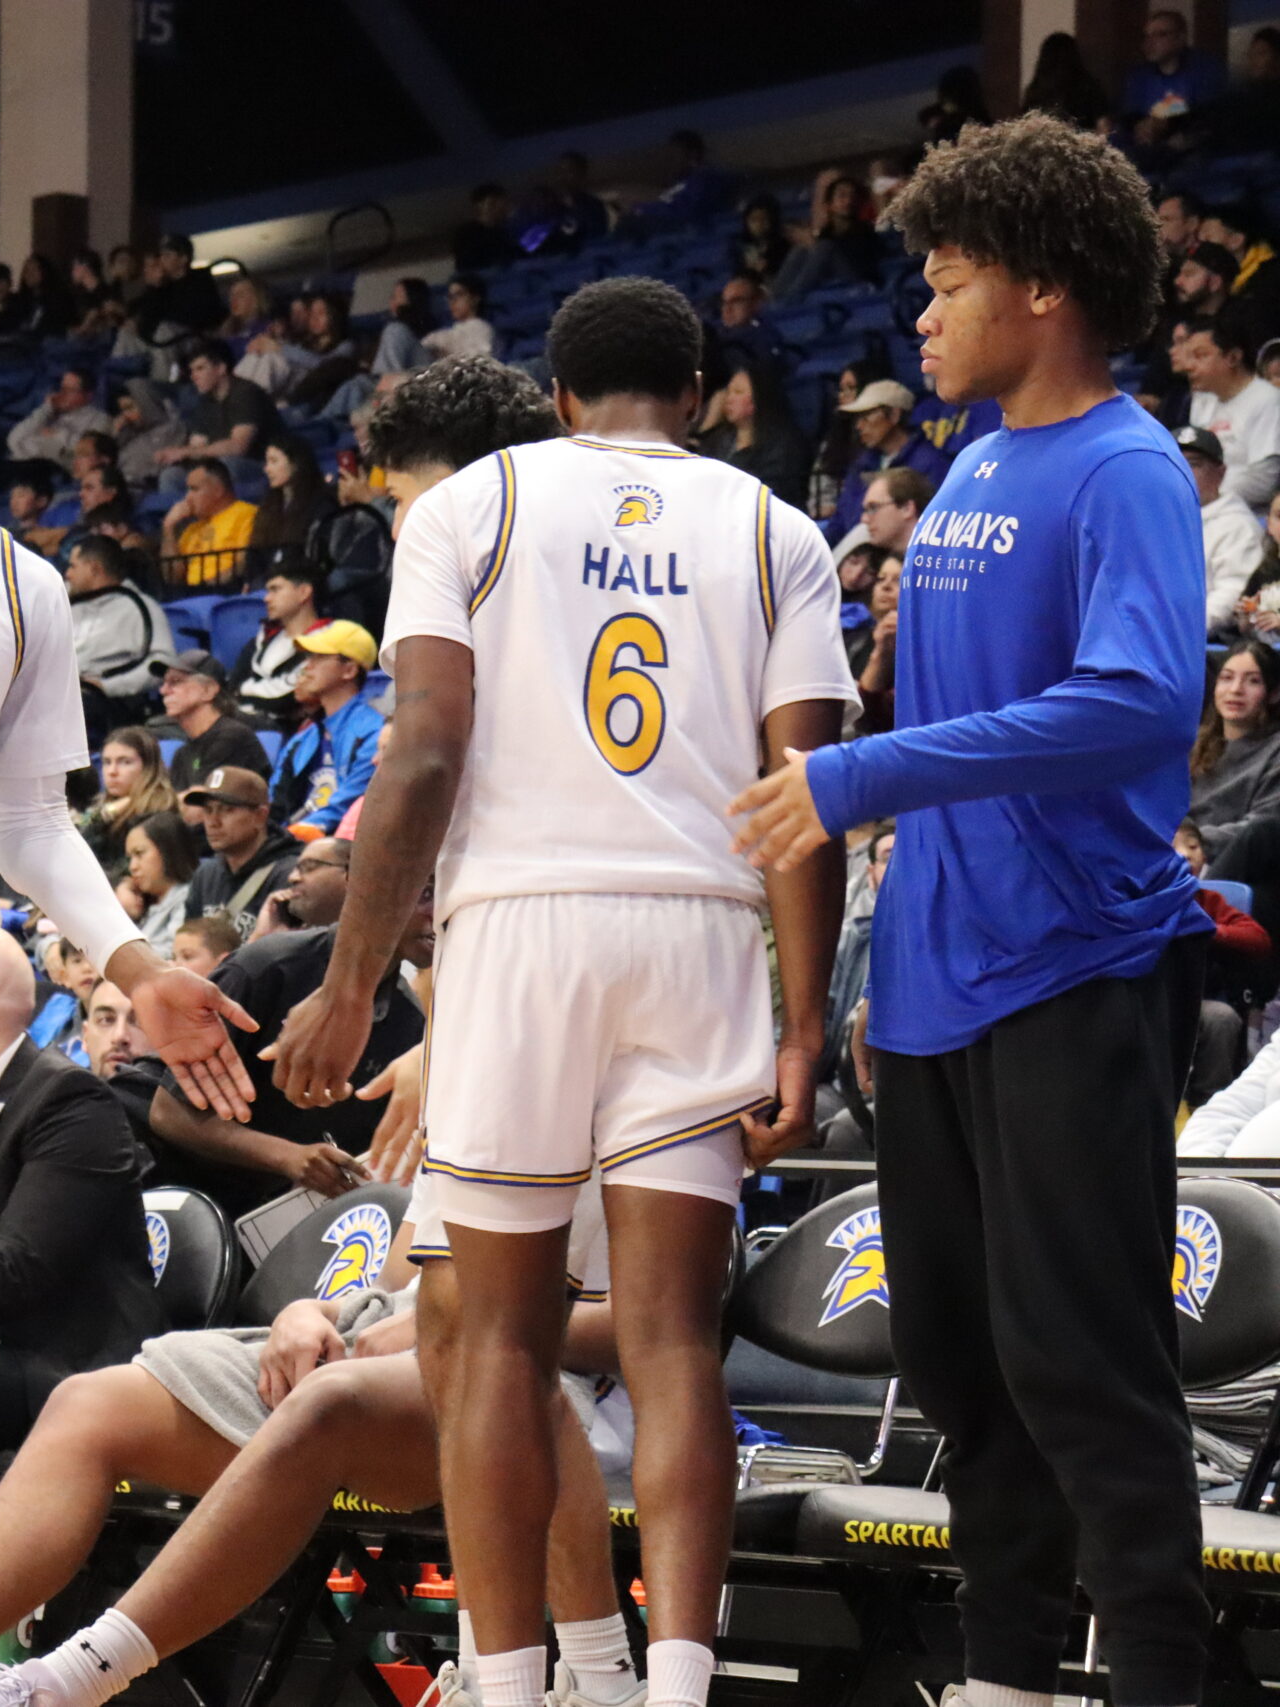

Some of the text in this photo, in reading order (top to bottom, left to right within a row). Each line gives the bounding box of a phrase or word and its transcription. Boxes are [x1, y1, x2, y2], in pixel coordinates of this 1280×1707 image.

[913, 510, 1019, 554] ALWAYS
[583, 542, 688, 596] HALL
[947, 557, 986, 573] STATE
[583, 612, 668, 776] 6
